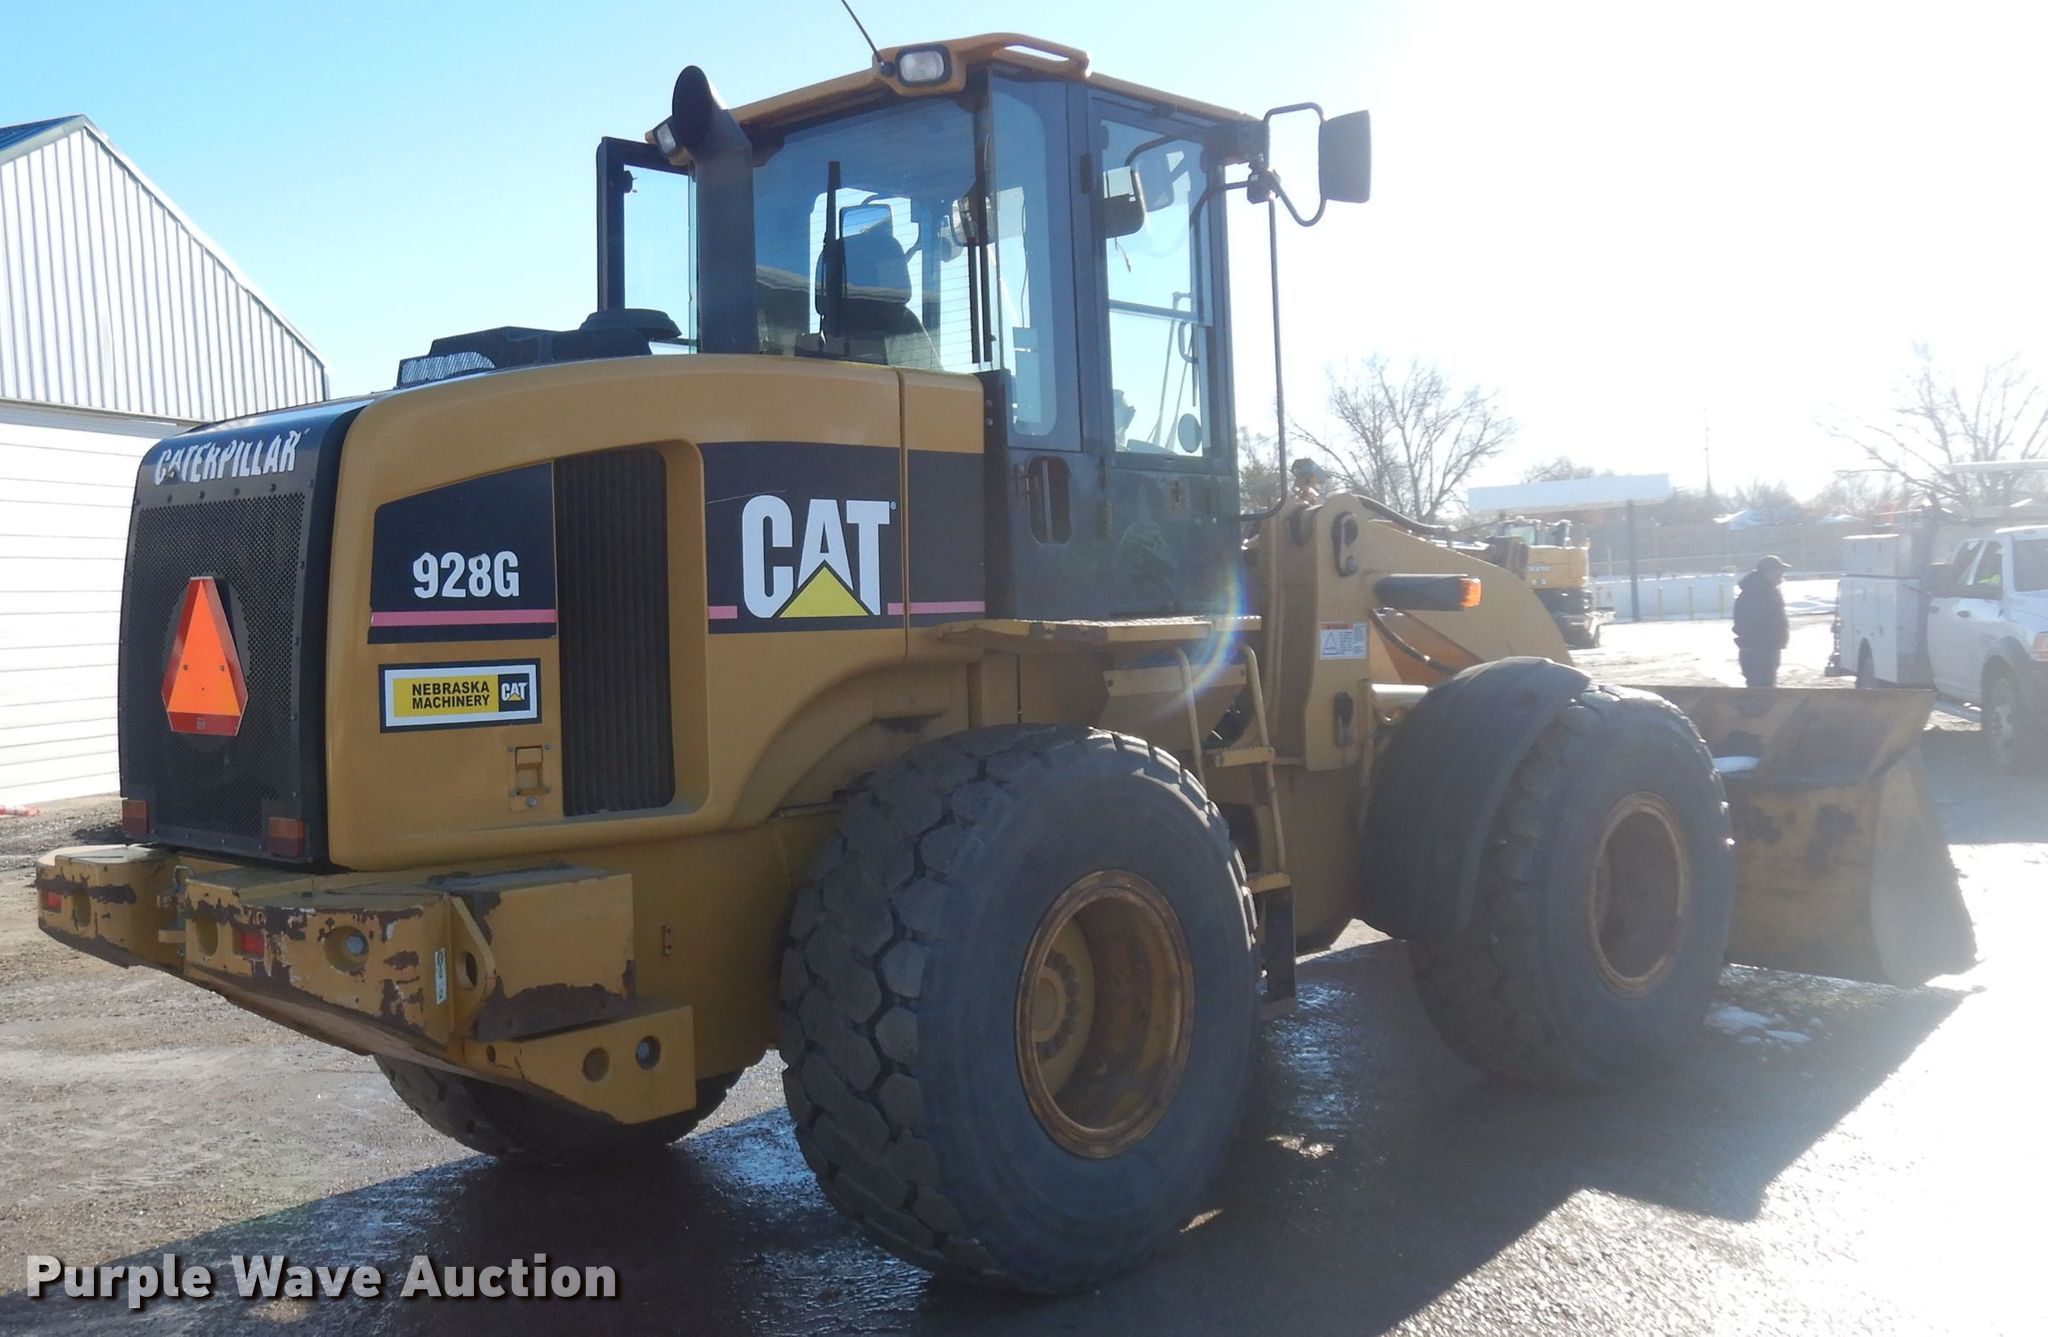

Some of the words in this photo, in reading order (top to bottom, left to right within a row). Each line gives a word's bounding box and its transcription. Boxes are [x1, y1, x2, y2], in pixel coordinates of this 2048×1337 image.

[154, 430, 301, 485] CATERPILLAR
[741, 494, 891, 619] CAT
[412, 551, 520, 599] 928G
[411, 680, 490, 696] NEBRASKA
[411, 694, 490, 710] MACHINERY
[501, 682, 528, 701] CAT
